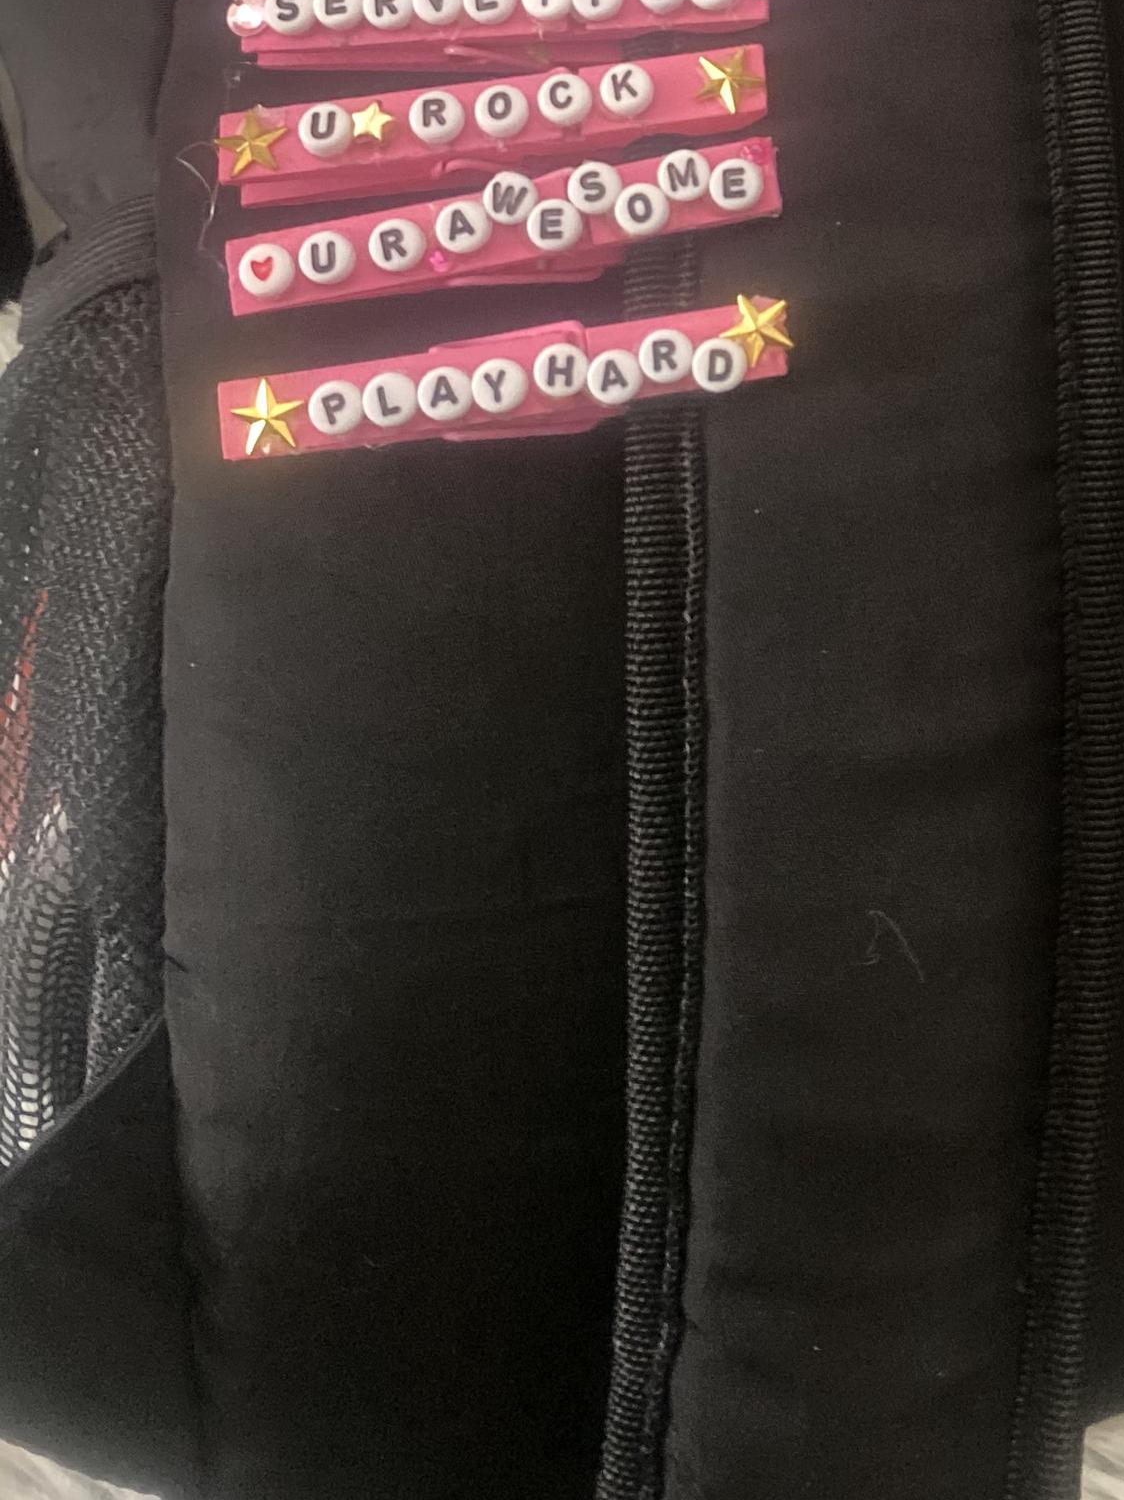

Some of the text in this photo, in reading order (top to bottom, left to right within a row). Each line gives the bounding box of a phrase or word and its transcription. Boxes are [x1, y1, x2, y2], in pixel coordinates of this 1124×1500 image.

[422, 69, 639, 129] ROCK
[448, 155, 748, 240] AWESOME
[322, 337, 735, 426] PLAY HARD
